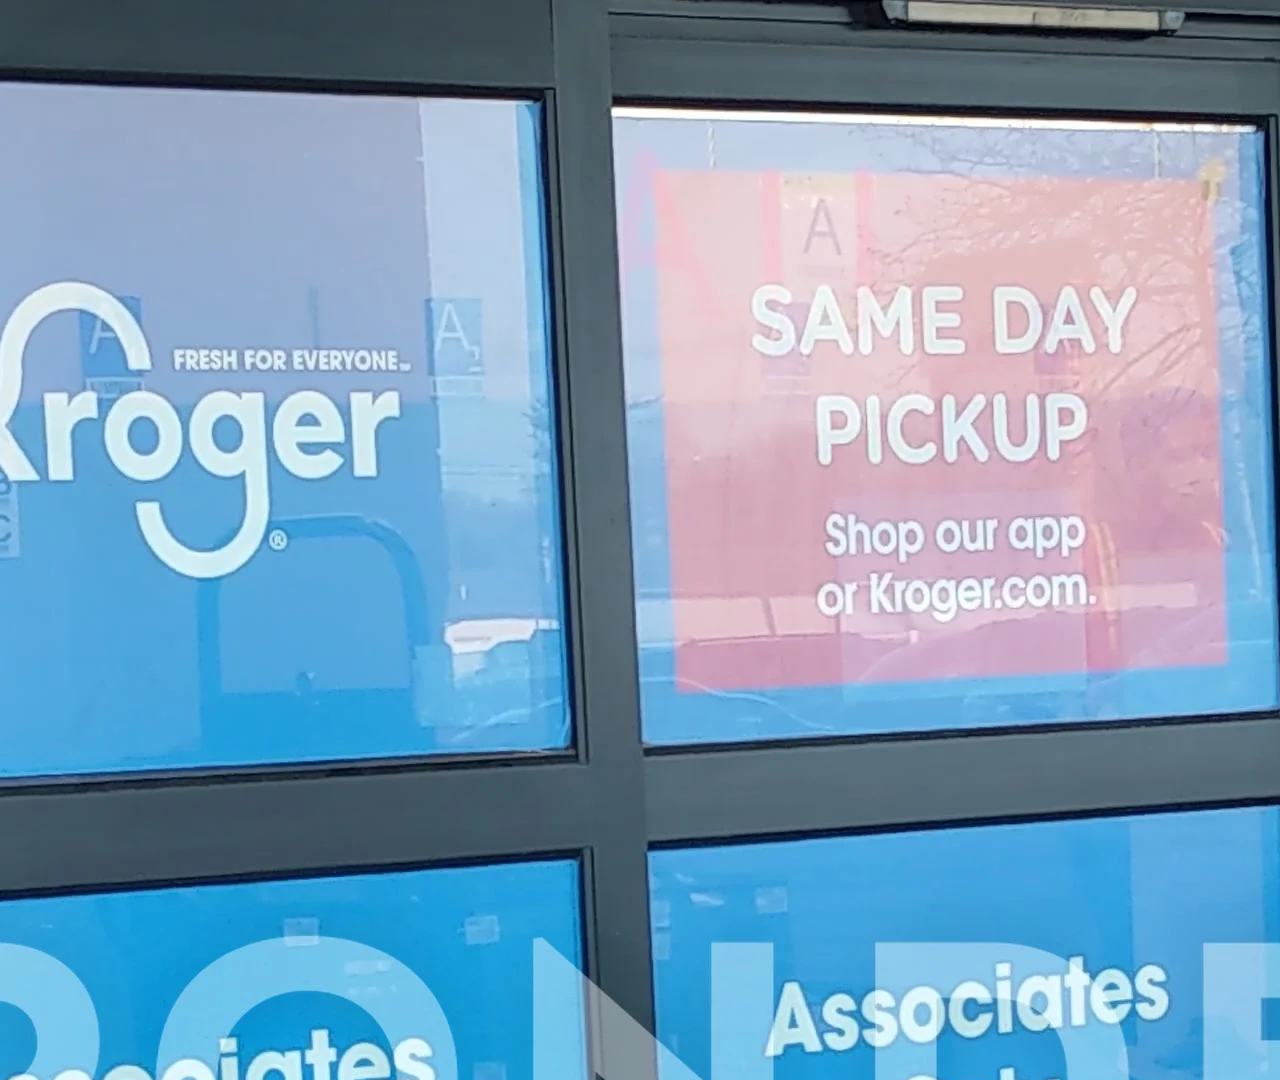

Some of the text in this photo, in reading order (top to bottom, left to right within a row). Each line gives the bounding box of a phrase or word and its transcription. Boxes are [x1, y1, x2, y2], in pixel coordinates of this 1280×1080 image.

[749, 284, 1139, 356] SAME DAY
[173, 348, 238, 371] FRESH
[243, 349, 287, 371] FOR
[815, 393, 1089, 467] PICKUP
[824, 513, 1087, 562] Shop our app
[816, 571, 1097, 623] or Kroger.com.
[764, 956, 1171, 1058] Associates
